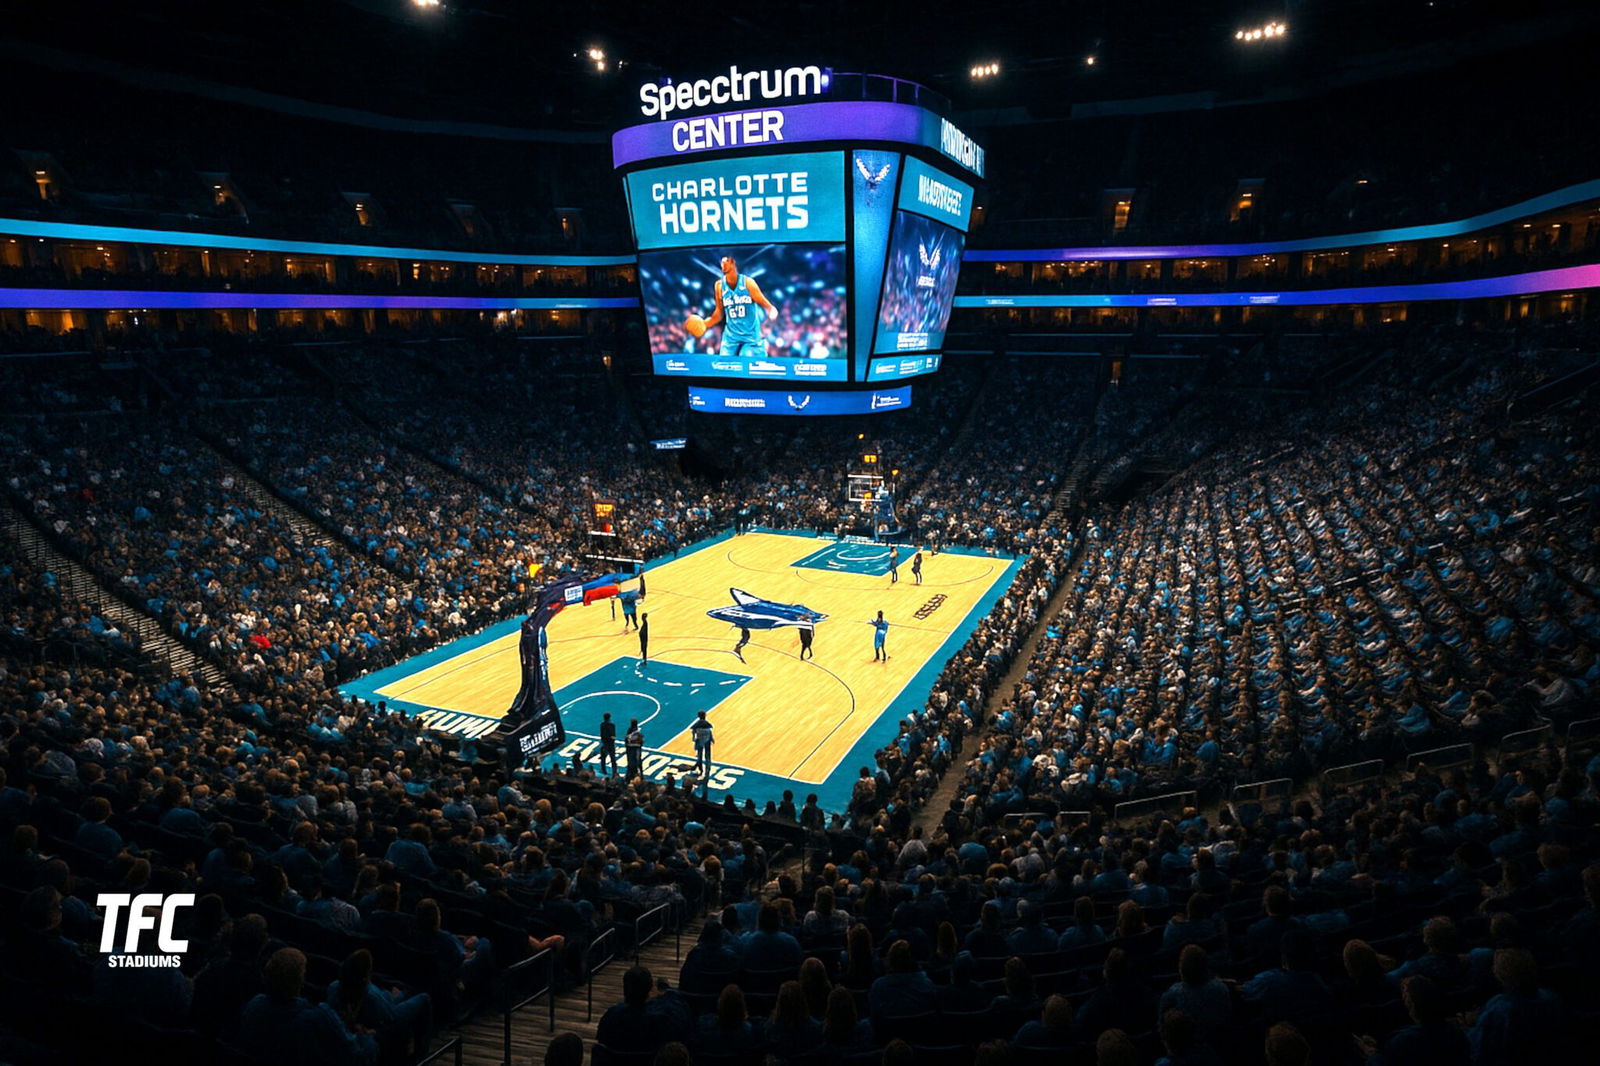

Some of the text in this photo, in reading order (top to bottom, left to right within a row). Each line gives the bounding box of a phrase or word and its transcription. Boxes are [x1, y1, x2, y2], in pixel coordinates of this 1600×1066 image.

[640, 65, 821, 120] Specctrum
[672, 110, 784, 151] CENTER
[652, 172, 808, 202] CHARLOTTE
[660, 195, 809, 234] HORNETS
